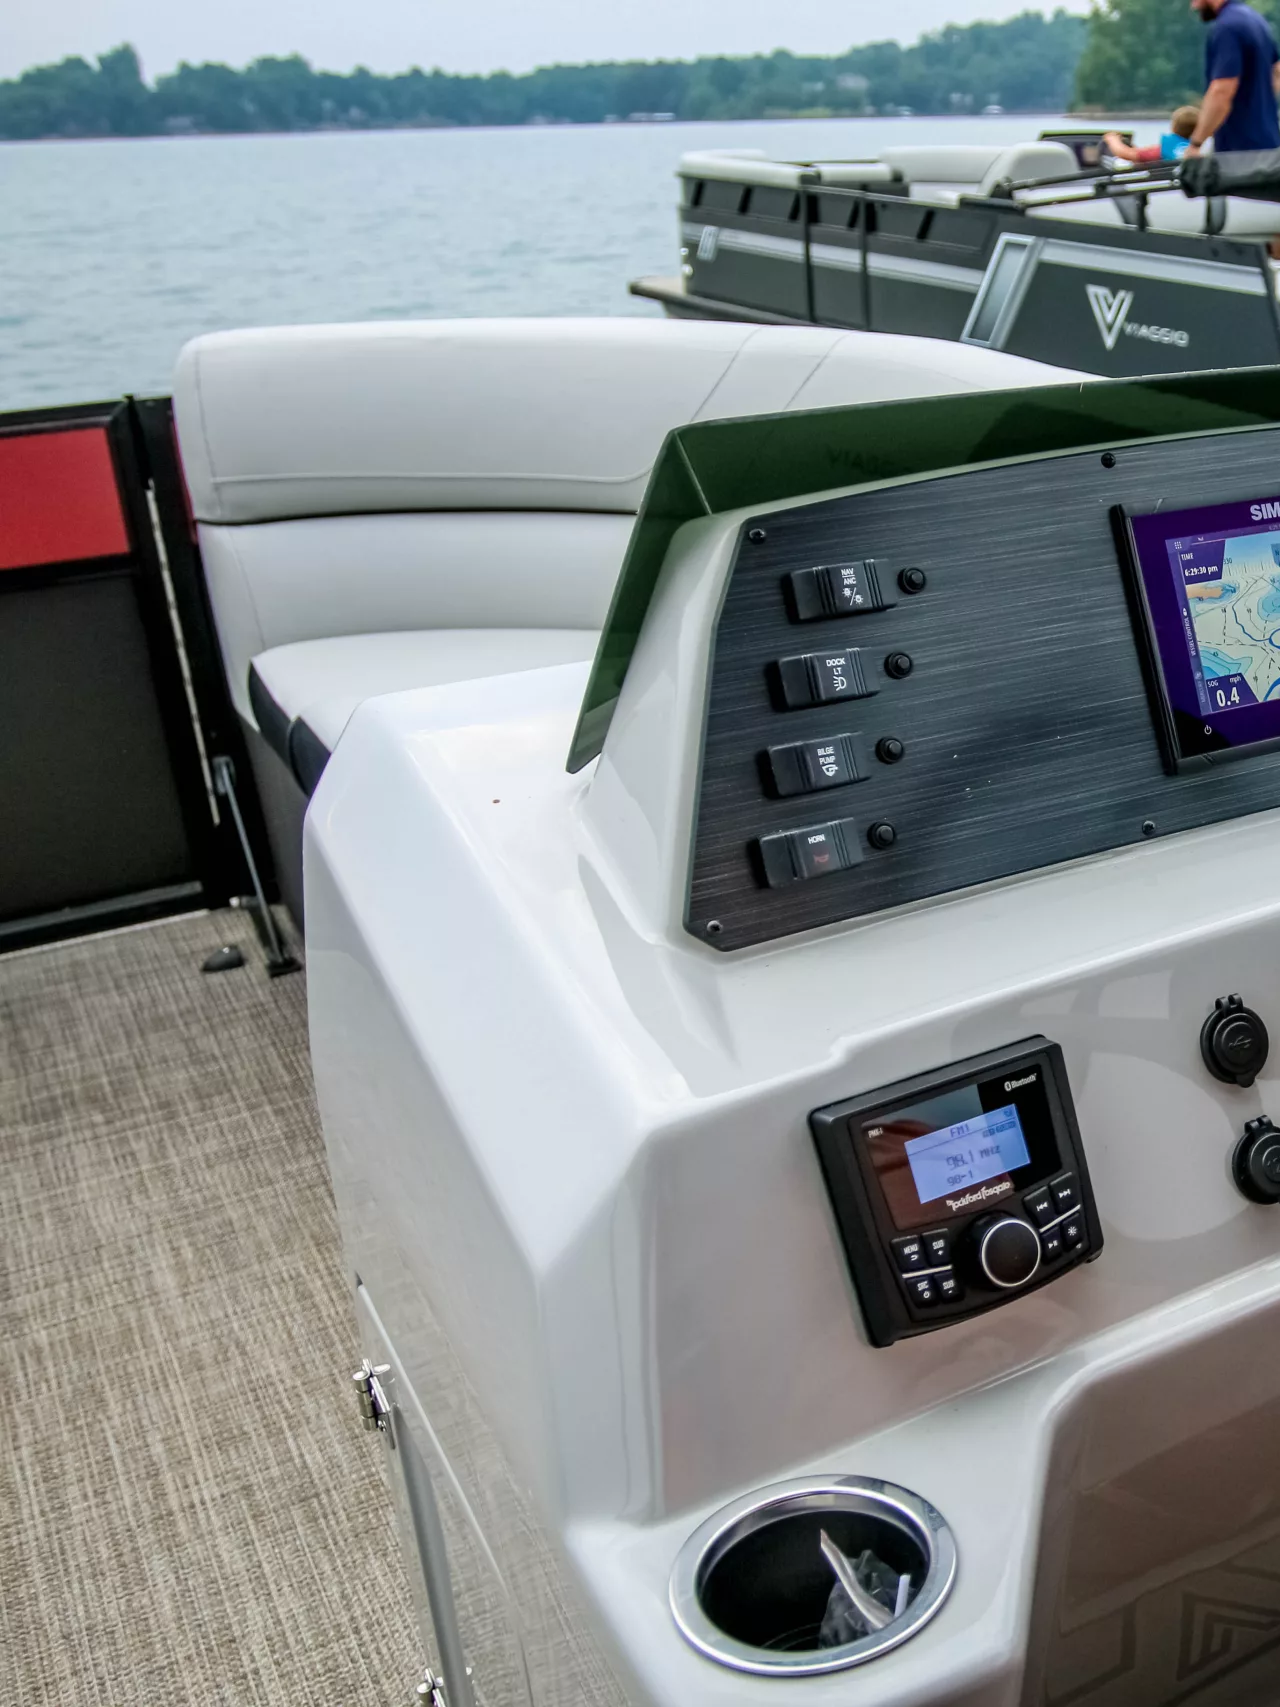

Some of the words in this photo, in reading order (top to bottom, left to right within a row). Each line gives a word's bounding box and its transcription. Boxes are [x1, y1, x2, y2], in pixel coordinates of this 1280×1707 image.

[1181, 552, 1194, 561] TIME
[841, 568, 854, 576] NAV
[1184, 566, 1207, 577] 6:29:30
[1207, 565, 1219, 575] pm
[844, 577, 857, 586] ANC
[1184, 617, 1193, 639] CONTROL
[1189, 639, 1197, 657] VESSEL
[826, 657, 846, 667] DOCK
[833, 667, 842, 675] LT
[1229, 675, 1242, 684] mph
[1216, 686, 1240, 707] 0.4
[817, 746, 835, 756] BILGE
[819, 755, 836, 765] PUMP
[808, 833, 826, 844] HORN
[1010, 1073, 1037, 1089] Bluetooth
[946, 1149, 975, 1171] 98.1
[903, 1243, 918, 1255] MENU
[932, 1239, 945, 1250] SUB
[917, 1280, 929, 1291] SRC
[942, 1279, 955, 1290] SUB
